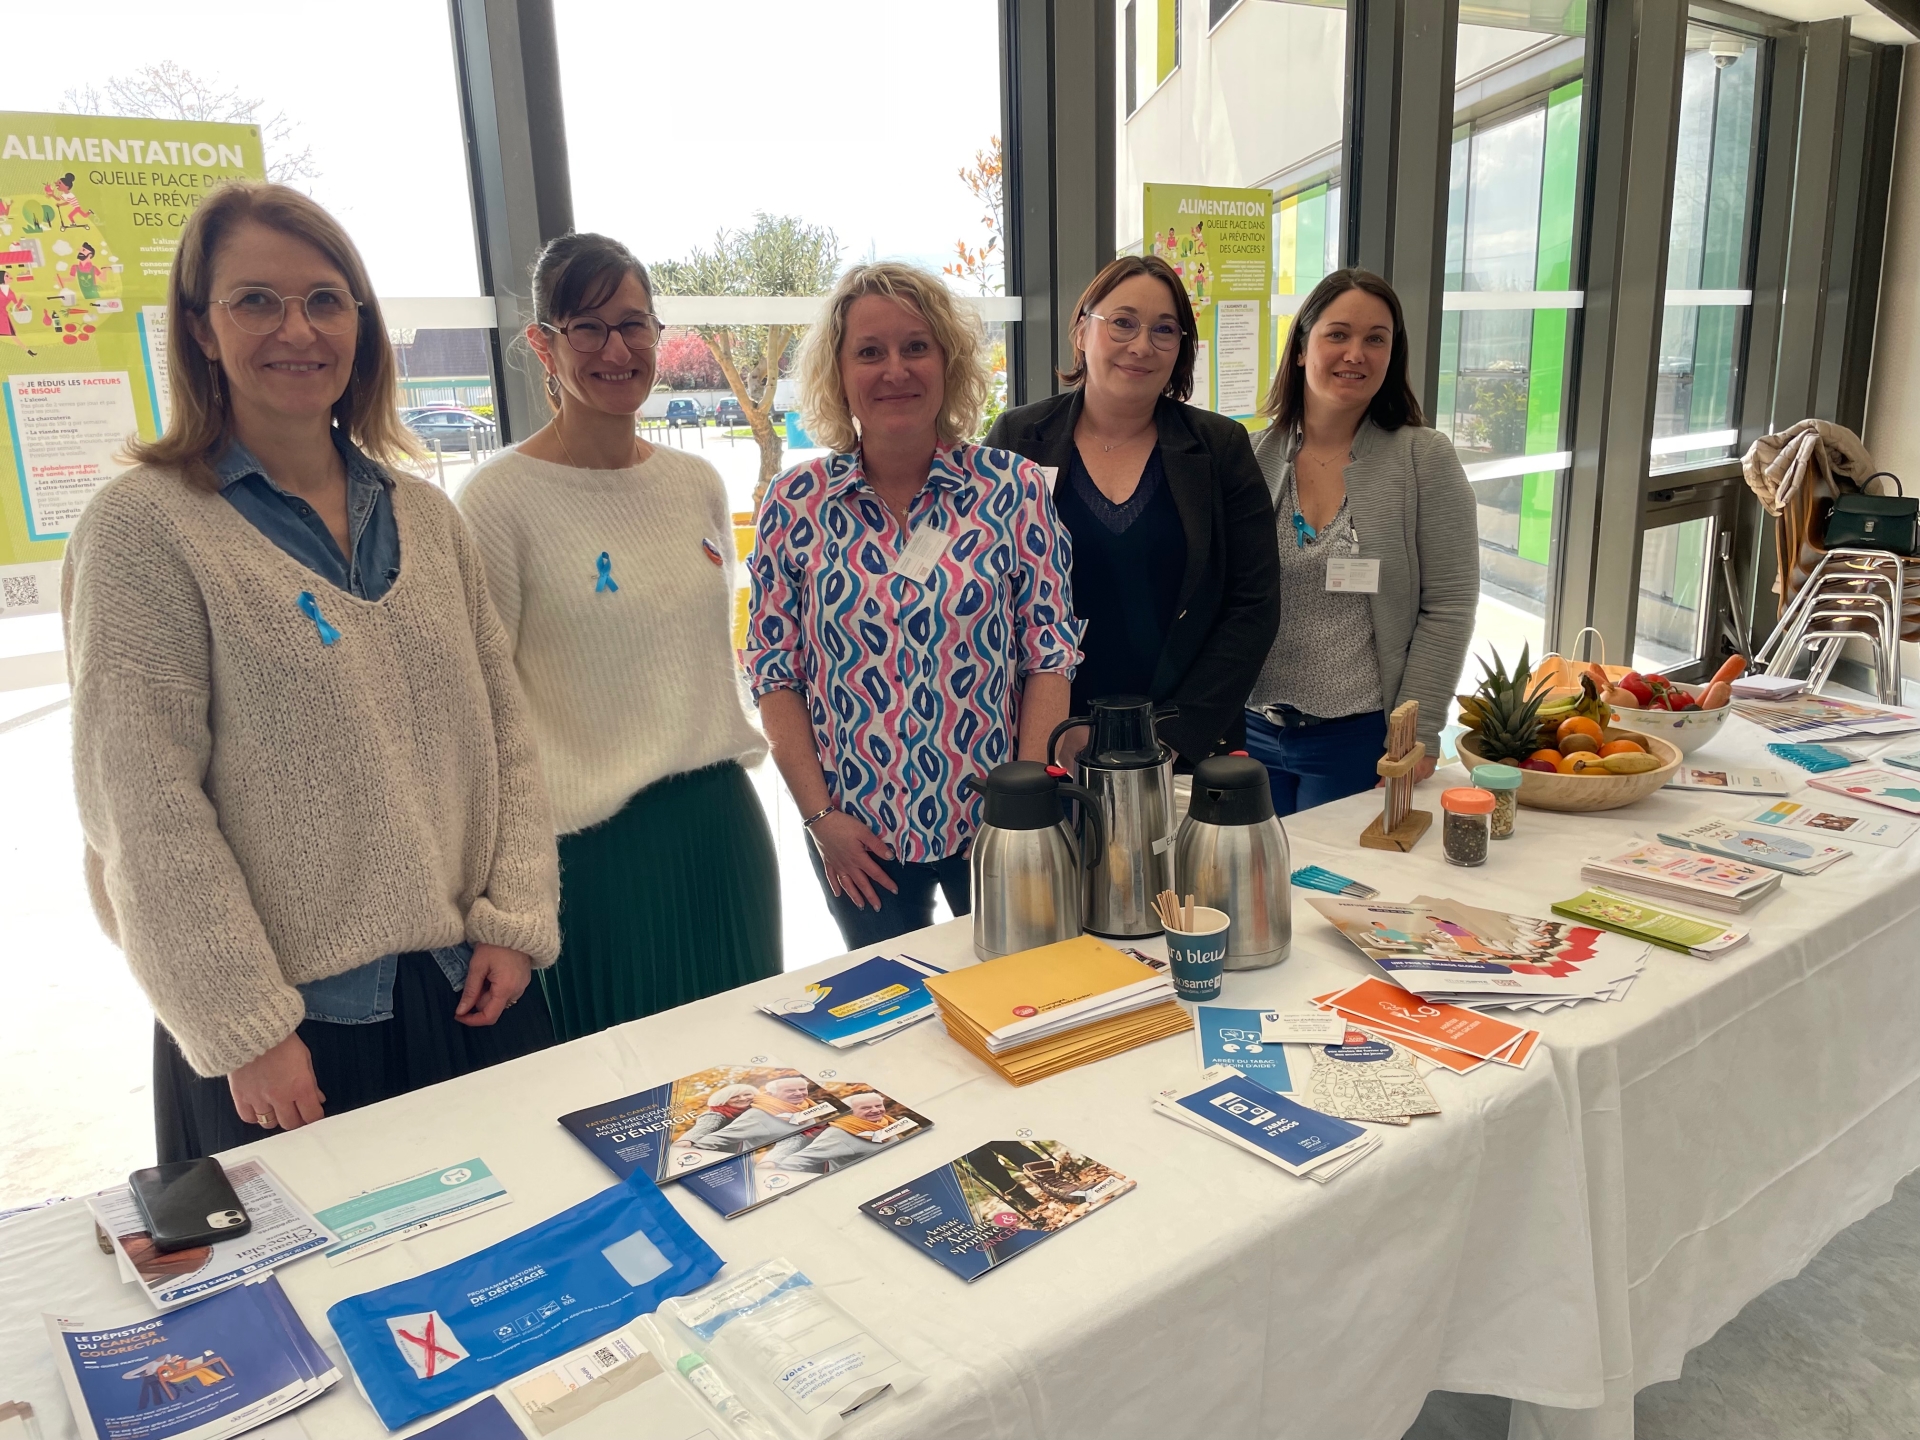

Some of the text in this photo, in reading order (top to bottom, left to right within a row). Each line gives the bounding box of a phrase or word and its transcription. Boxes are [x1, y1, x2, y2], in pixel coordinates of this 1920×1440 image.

[1, 135, 244, 168] ALIMENTATION
[89, 170, 147, 186] QUELLE
[152, 172, 198, 188] PLACE
[130, 192, 149, 206] LA
[1178, 198, 1265, 217] ALIMENTATION
[133, 212, 163, 227] DES
[1207, 219, 1265, 230] QUELLE PLACE DANS
[1220, 231, 1265, 241] LA PRÉVENTION
[1220, 245, 1230, 253] DES
[1232, 245, 1260, 254] CANCERS
[27, 378, 121, 388] JE RÉDUIS LES FACTEURS
[31, 387, 61, 396] RISQUE
[1186, 947, 1226, 964] bleu
[585, 1115, 617, 1129] FATIGUE
[626, 1103, 659, 1117] CANCER
[596, 1102, 685, 1133] MON PROGRAMME
[612, 1110, 701, 1143] D'ÉNERGIE
[1262, 1118, 1288, 1132] TABAC
[595, 1127, 622, 1138] POUR
[621, 1121, 643, 1133] FAIRE
[643, 1117, 655, 1126] LE
[1267, 1120, 1300, 1138] ET ADOS
[925, 1217, 960, 1238] Activité
[1002, 1214, 1018, 1226] &
[236, 1227, 313, 1259] Chocolat
[923, 1223, 972, 1250] physique,
[948, 1220, 992, 1247] Activité
[950, 1225, 1001, 1257] sportive
[974, 1226, 1020, 1253] CANCER
[183, 1272, 238, 1294] Mars bleu
[466, 1263, 541, 1298] PROGRAMME NATIONAL
[470, 1268, 546, 1305] DE DÉPISTAGE
[74, 1335, 90, 1344] LE
[91, 1320, 164, 1343] DÉPISTAGE
[99, 1330, 157, 1349] CANCER
[79, 1336, 169, 1358] COLORECTAL
[782, 1364, 807, 1382] Volet
[791, 1353, 856, 1391] tube de prélèvement
[796, 1356, 862, 1395] sachet de protection
[801, 1361, 864, 1399] enveloppe de retour
